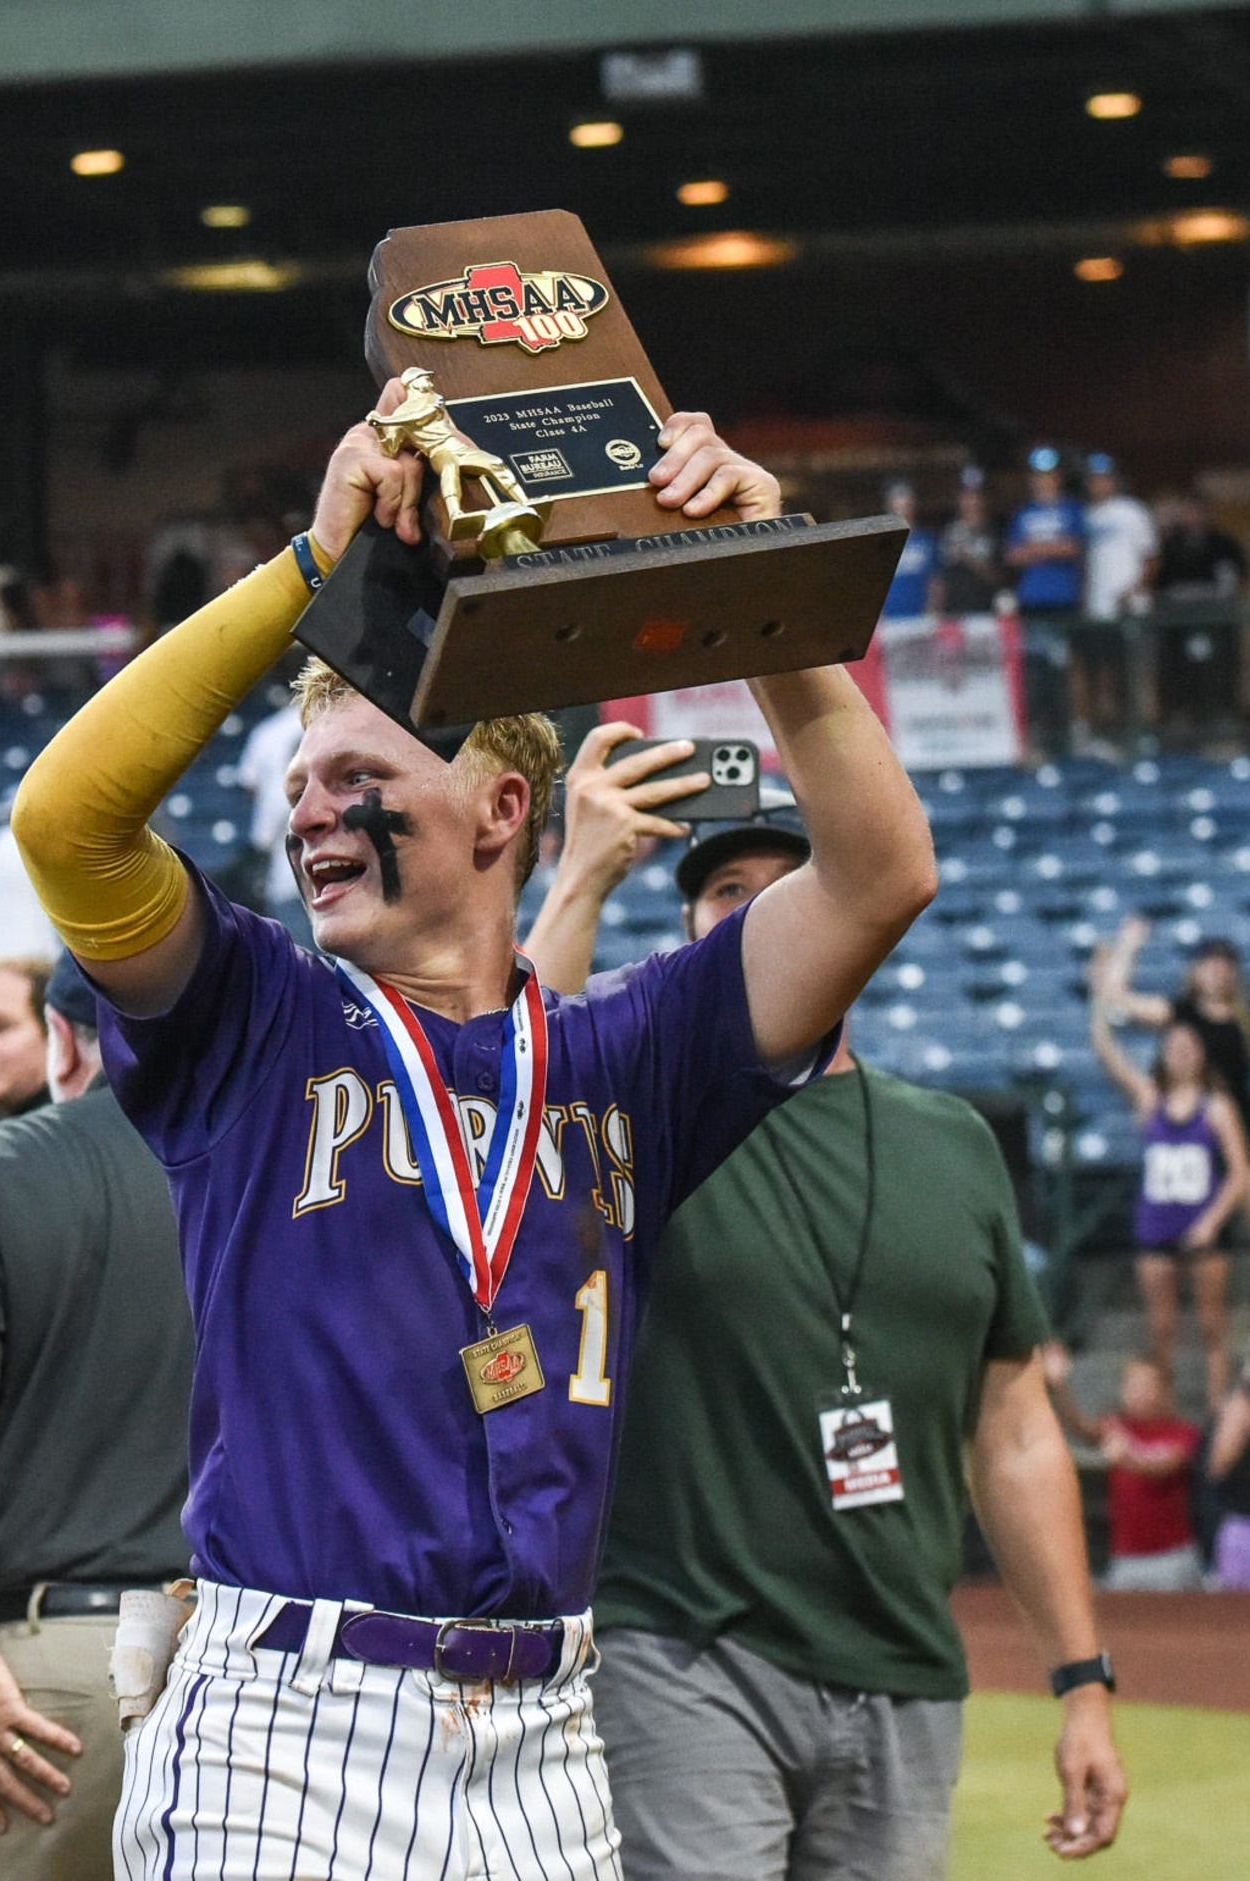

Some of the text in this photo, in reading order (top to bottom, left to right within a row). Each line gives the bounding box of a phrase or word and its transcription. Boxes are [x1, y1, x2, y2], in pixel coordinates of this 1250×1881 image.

[414, 277, 587, 330] MHSAA
[513, 310, 587, 342] 100
[483, 398, 615, 424] 2023 MHSAA Baseball
[509, 411, 601, 431] State Champion
[535, 424, 587, 438] Class 4A
[520, 460, 562, 472] BUREAU
[528, 453, 558, 463] FARM
[568, 1269, 611, 1408] 1
